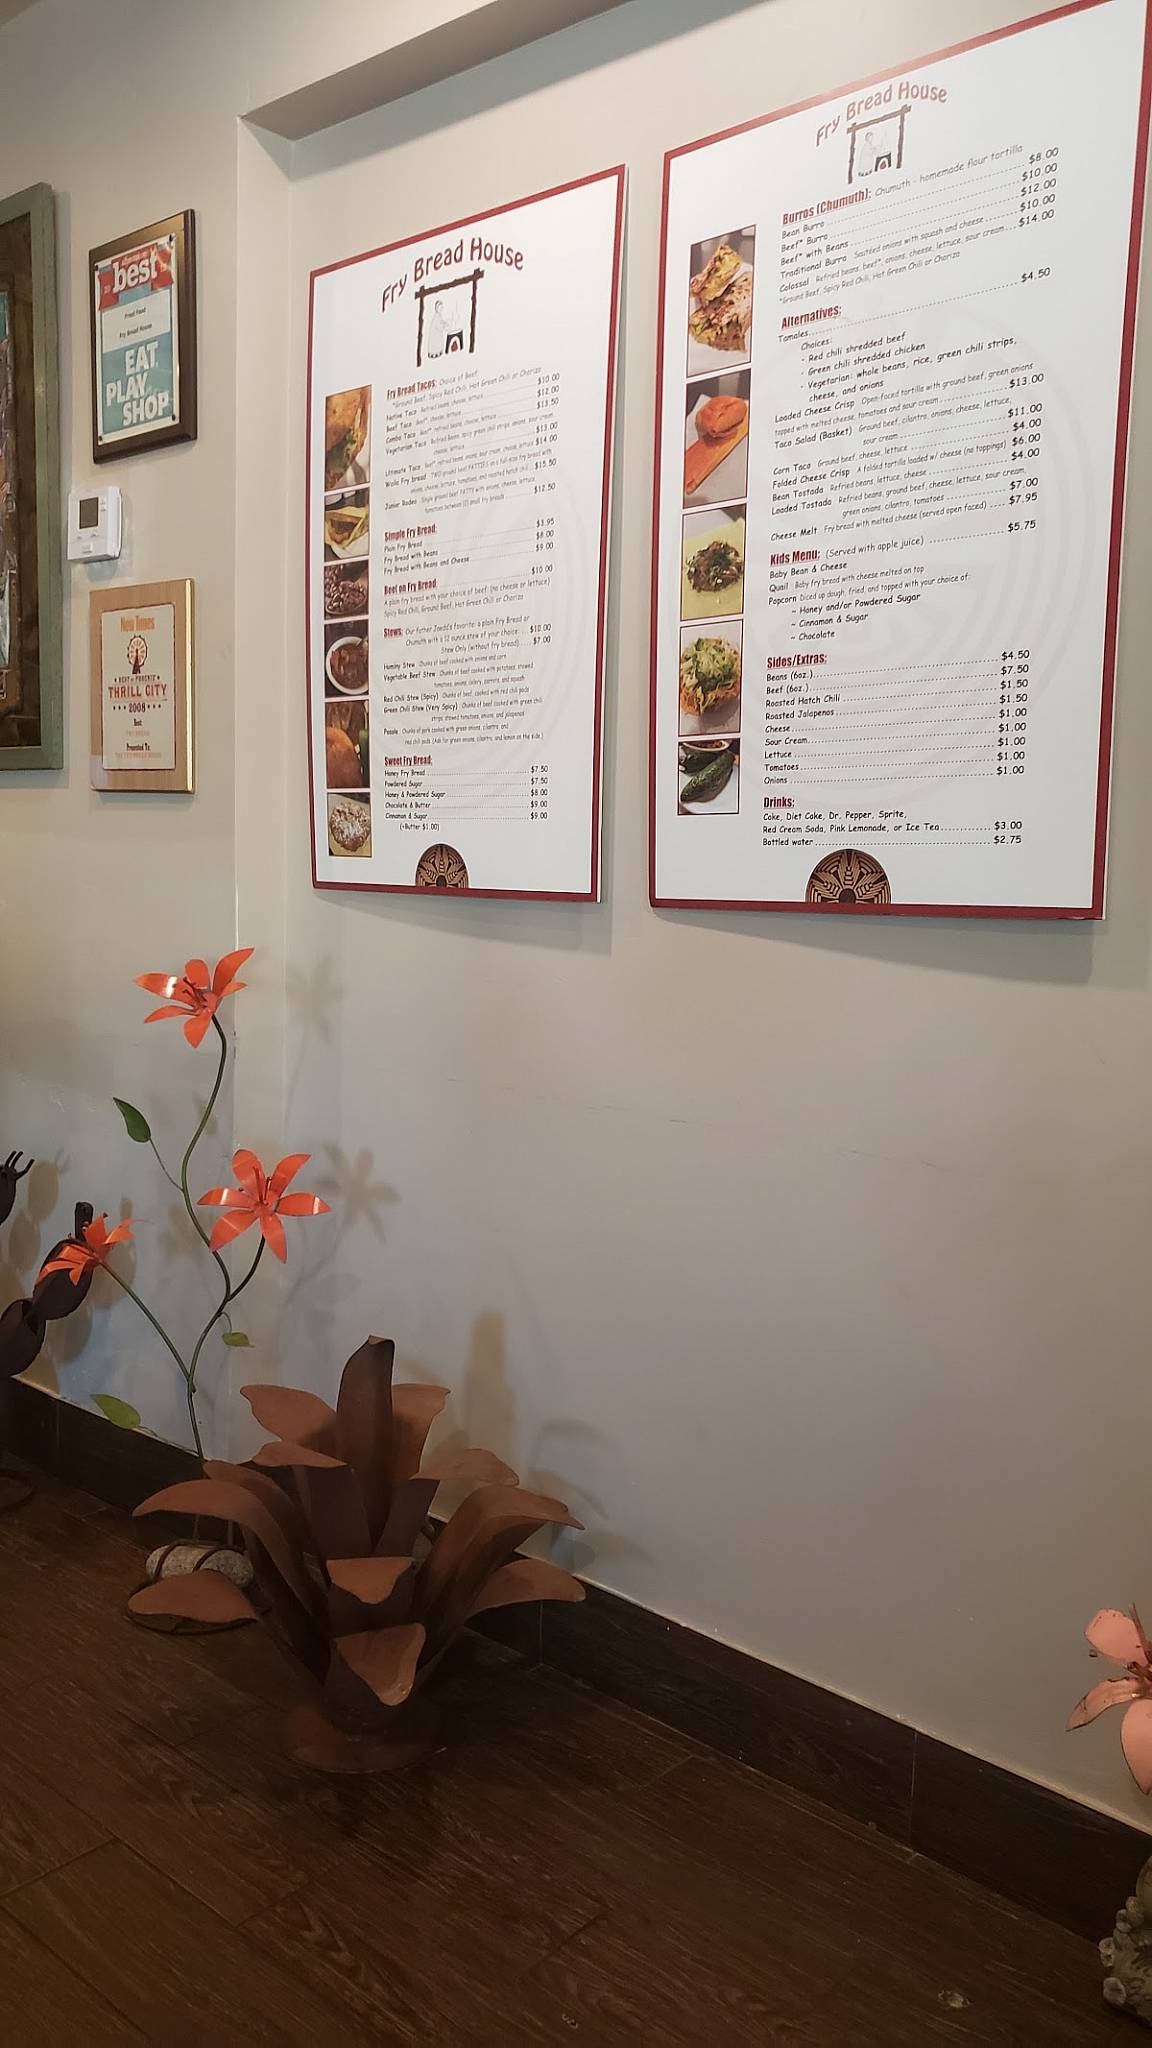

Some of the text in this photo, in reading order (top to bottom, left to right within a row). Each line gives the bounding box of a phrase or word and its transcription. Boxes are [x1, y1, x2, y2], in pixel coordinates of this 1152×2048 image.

[816, 81, 947, 147] Fry Bread House
[782, 207, 814, 225] Burros
[874, 178, 910, 196] Chumuth
[919, 162, 964, 183] homemade
[967, 155, 988, 168] flour
[991, 144, 1023, 160] tortilla
[782, 147, 1059, 239] Bean Burro $8.00
[806, 233, 828, 245] Burro
[1022, 162, 1057, 182] $10.00
[806, 247, 822, 258] with
[825, 241, 848, 253] Beans
[1020, 178, 1056, 197] $12.00
[112, 246, 158, 294] best
[382, 237, 524, 313] Fry Bread House
[781, 305, 841, 329] Alternatives:
[801, 338, 832, 351] Choices:
[808, 331, 905, 362] Red chili shredded beef
[807, 337, 1016, 389] Vegetarian: whole beans, rice, green chili strips,
[808, 343, 925, 376] Green chili shredded chicken
[387, 389, 396, 400] Fry
[397, 383, 415, 397] Bread
[770, 491, 1037, 541] Cheese Melt Fry bread with melted cheese (served open faced) $7.95
[384, 529, 405, 542] Simple
[406, 527, 416, 538] Fry
[770, 519, 1036, 566] Kids Menu: (Served with apple juice) $5.75
[383, 567, 392, 575] Fry
[394, 564, 409, 573] Bread
[423, 561, 438, 569] Beans
[439, 558, 449, 566] and
[450, 556, 469, 564] Cheese
[535, 541, 553, 552] $9.00
[383, 556, 393, 565] Fry
[394, 553, 409, 562] Bread
[384, 584, 397, 595] Beef
[398, 584, 406, 593] on
[407, 582, 416, 592] Fry
[531, 564, 552, 575] $10.00
[383, 628, 403, 638] Stews:
[441, 646, 454, 654] Stew
[454, 644, 466, 653] Only
[467, 642, 489, 652] (without
[491, 641, 499, 650] fry
[533, 635, 551, 645] $7.00
[766, 673, 787, 682] Beans
[1001, 649, 1030, 661] $4.50
[767, 654, 827, 668] Sides/Extras:
[108, 683, 168, 699] THRILL CITY
[765, 678, 1028, 708] Roasted Hatch Chili $1.50
[128, 702, 146, 713] 2008
[765, 693, 1028, 720] Roasted Jalapenos $1.50
[764, 722, 1026, 746] Sour Cream $1.00
[384, 755, 432, 766] Sweet Fry Bread:
[384, 765, 548, 778] Honey Fry Bread $7.50
[764, 751, 1025, 771] Tomatoes $1.00
[408, 780, 423, 789] Sugar
[530, 777, 548, 785] $7.50
[530, 800, 547, 809] $9.00
[763, 796, 794, 808] Drinks:
[762, 825, 776, 833] Red
[779, 825, 802, 833] Cream
[804, 824, 826, 833] Soda,
[829, 824, 845, 832] Pink
[848, 823, 889, 832] Lemonade,
[906, 823, 919, 831] Ice
[923, 822, 939, 830] Tea
[994, 821, 1022, 831] $3.00
[763, 810, 906, 821] Coke, Diet Coke, Dr. Pepper, Sprite,
[993, 834, 1021, 845] $2.75
